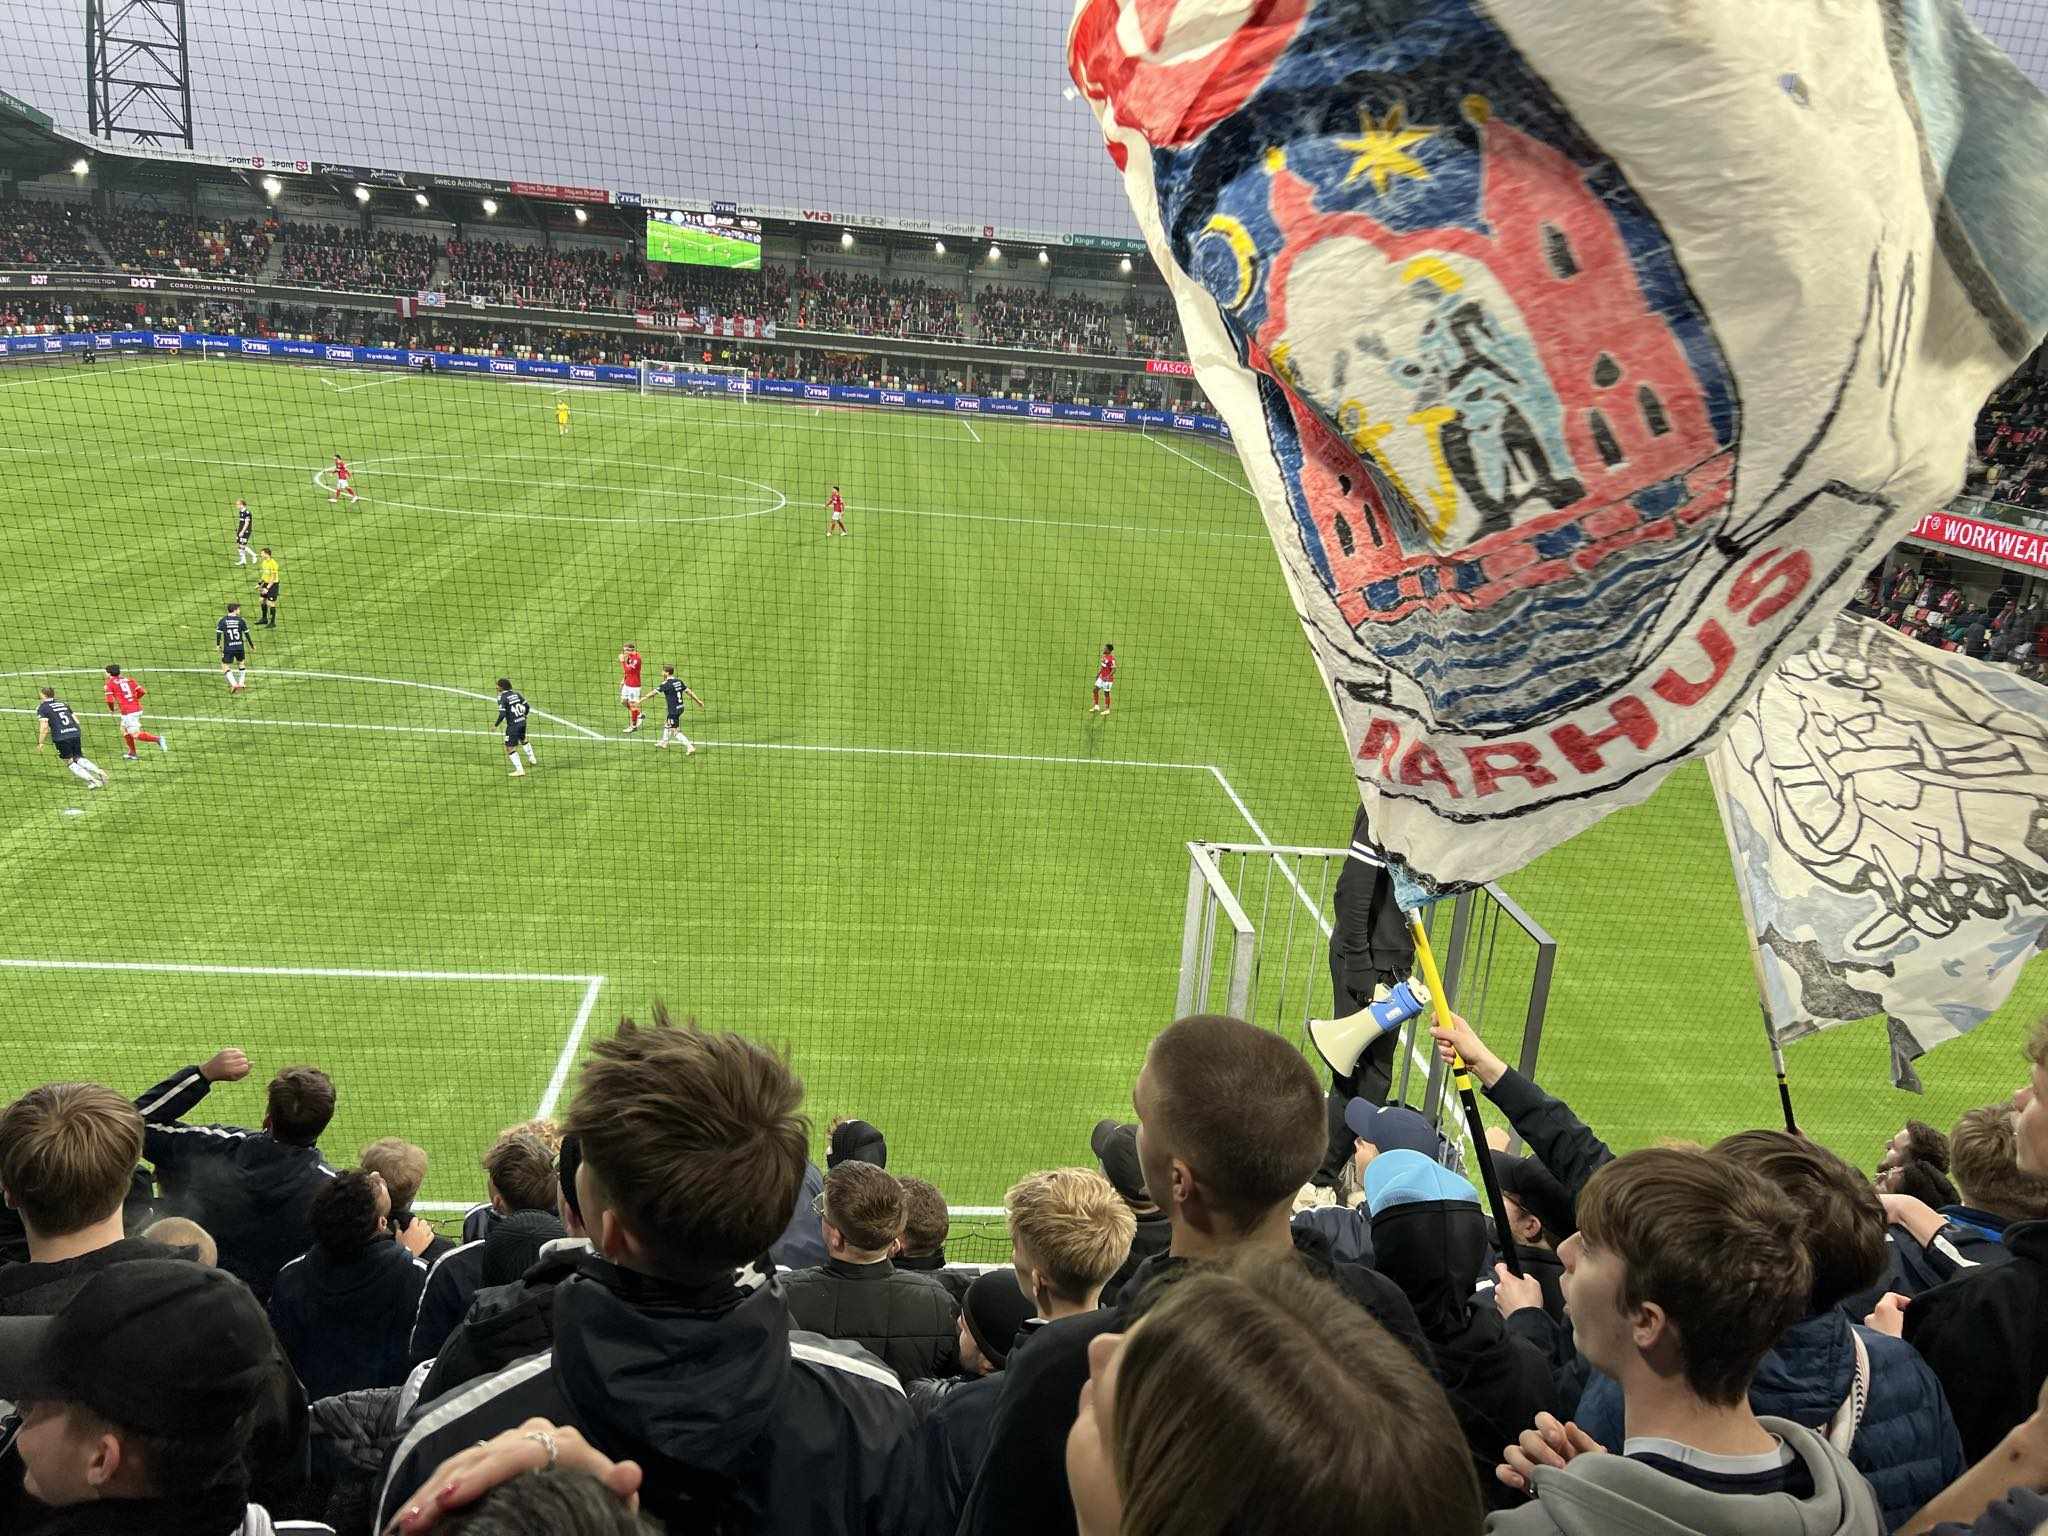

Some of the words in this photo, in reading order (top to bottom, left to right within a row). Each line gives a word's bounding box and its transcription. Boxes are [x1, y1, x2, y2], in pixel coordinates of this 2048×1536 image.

[434, 176, 456, 186] Sweco
[458, 178, 491, 190] Architects
[620, 194, 640, 203] JYSK
[715, 203, 735, 212] JYSK
[31, 275, 48, 285] DOT
[130, 278, 156, 288] DOT
[170, 282, 211, 290] CORROSION
[212, 286, 256, 294] PROTECTION
[653, 312, 679, 327] 1917
[159, 337, 180, 345] JYSK
[248, 342, 268, 351] JYSK
[333, 349, 352, 358] JYSK
[496, 363, 515, 371] JYSK
[1153, 362, 1194, 375] MASCOT
[576, 369, 595, 377] JYSK
[886, 394, 904, 402] JYSK
[960, 401, 978, 409] JYSK
[1034, 406, 1051, 414] JYSK
[1106, 411, 1124, 419] JYSK
[1177, 417, 1194, 426] JYSK
[1944, 518, 2048, 565] WORKWEAR
[227, 628, 240, 641] 15
[1358, 545, 1814, 799] AARHUS
[120, 682, 132, 698] 9
[60, 711, 69, 726] 5
